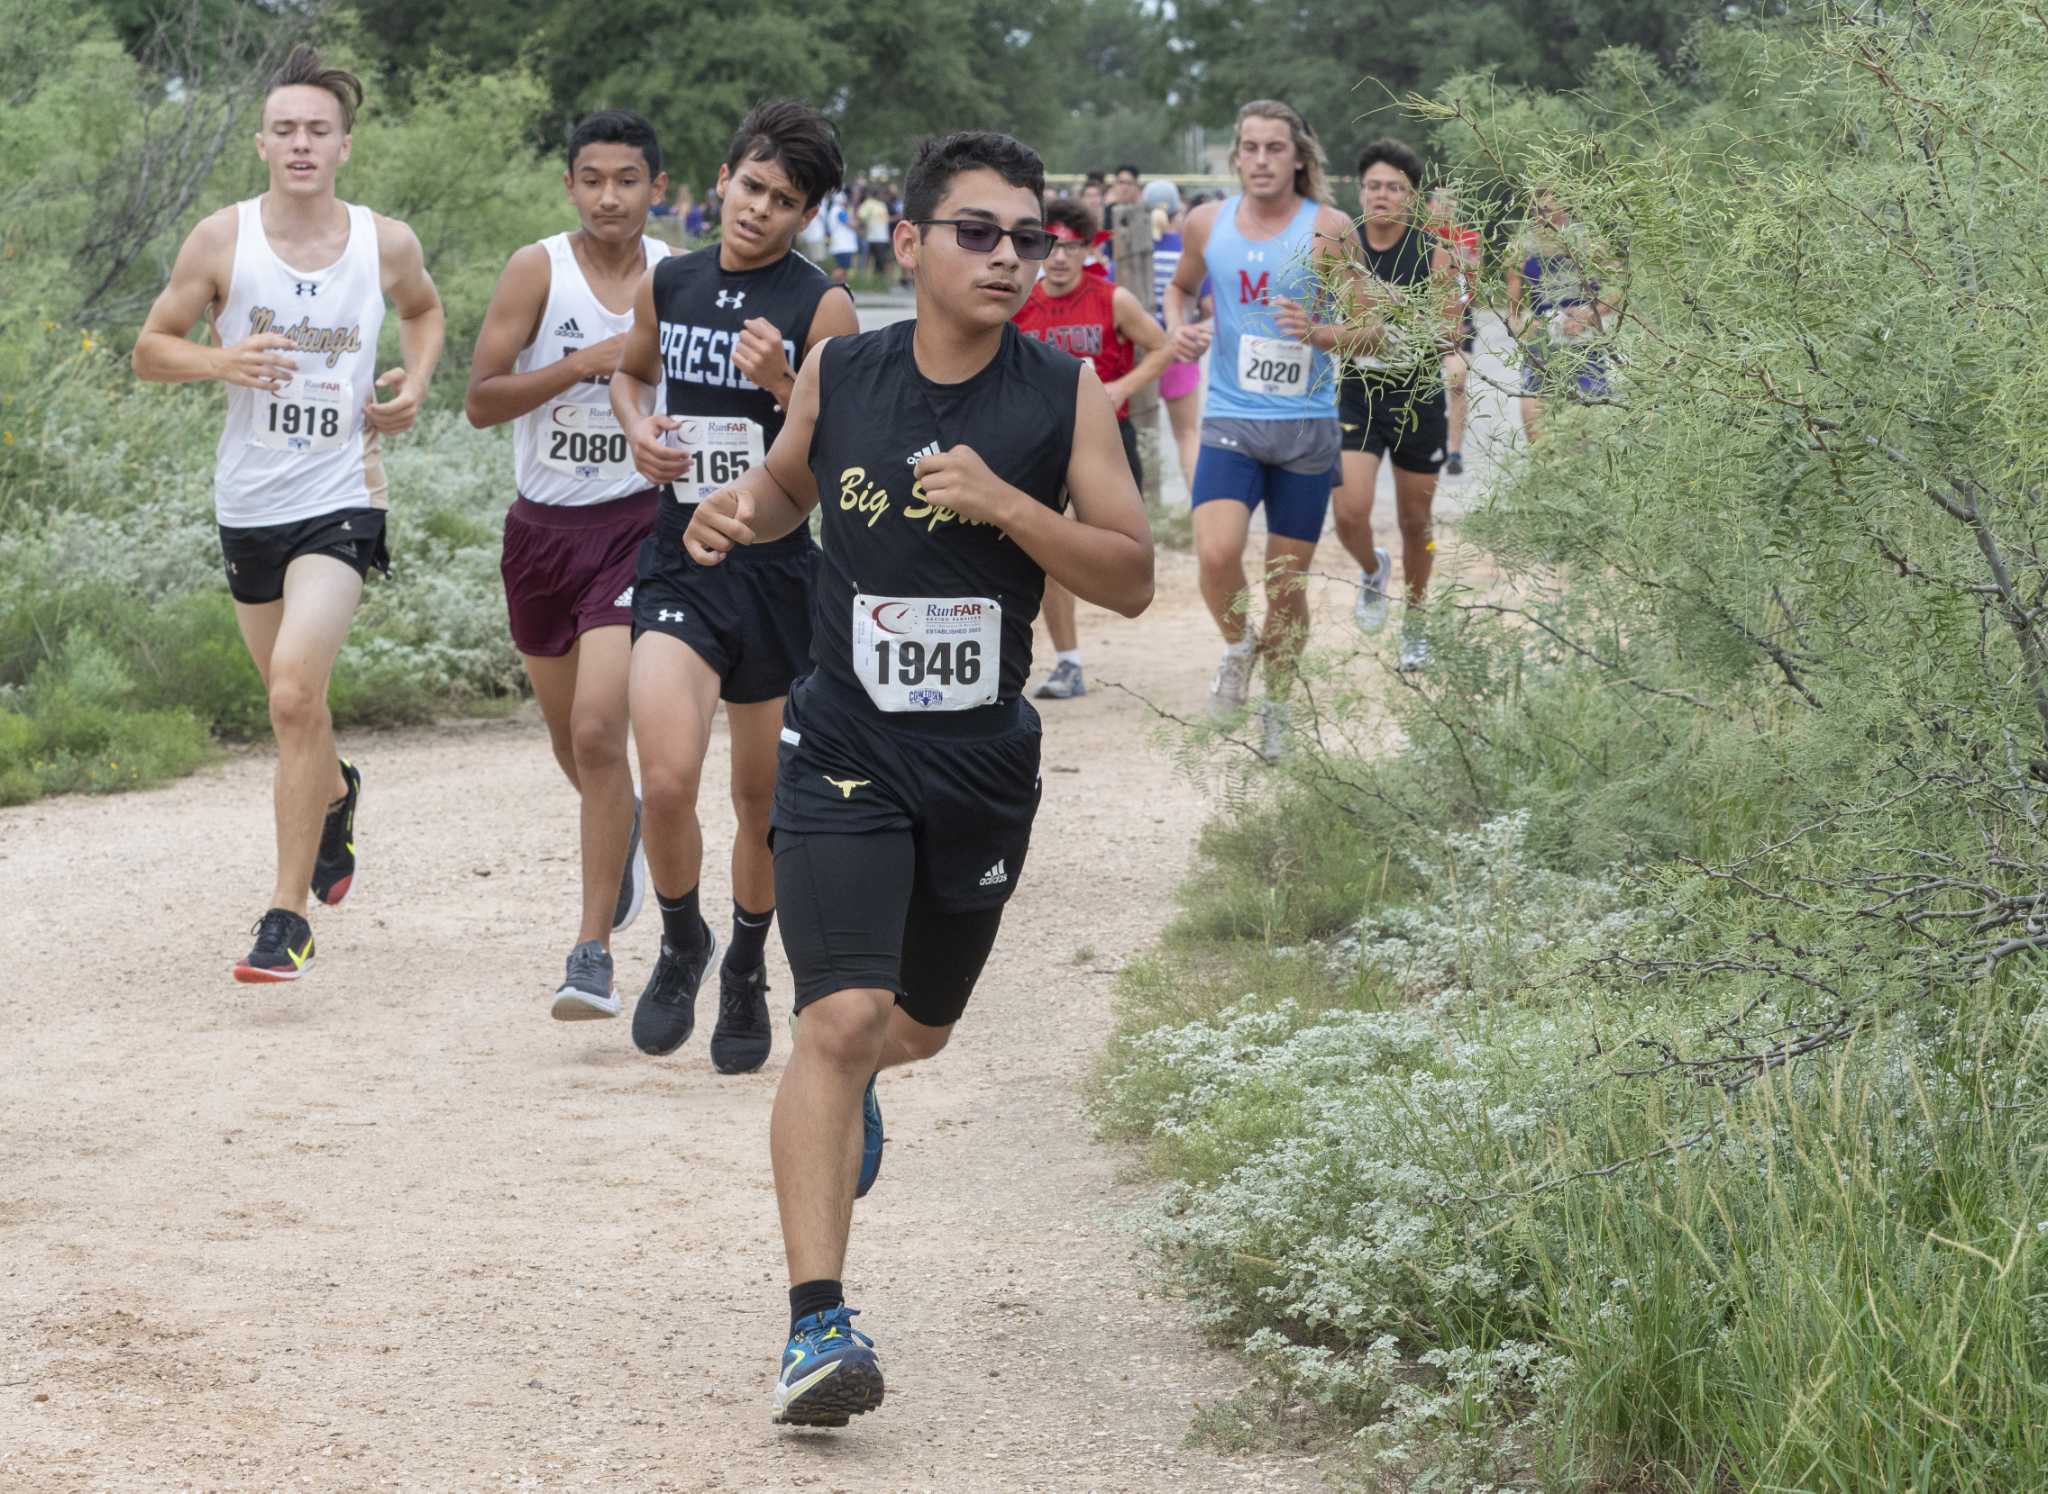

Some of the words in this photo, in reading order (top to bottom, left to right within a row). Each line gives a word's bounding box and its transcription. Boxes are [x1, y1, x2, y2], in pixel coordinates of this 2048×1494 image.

[1237, 270, 1270, 306] M
[1245, 357, 1301, 384] 2020
[269, 402, 339, 437] 1918
[708, 421, 748, 432] RunFAR
[549, 430, 628, 463] 2080
[674, 449, 750, 484] 165
[840, 466, 890, 528] Big
[926, 603, 982, 617] RunFAR
[874, 640, 981, 686] 1946
